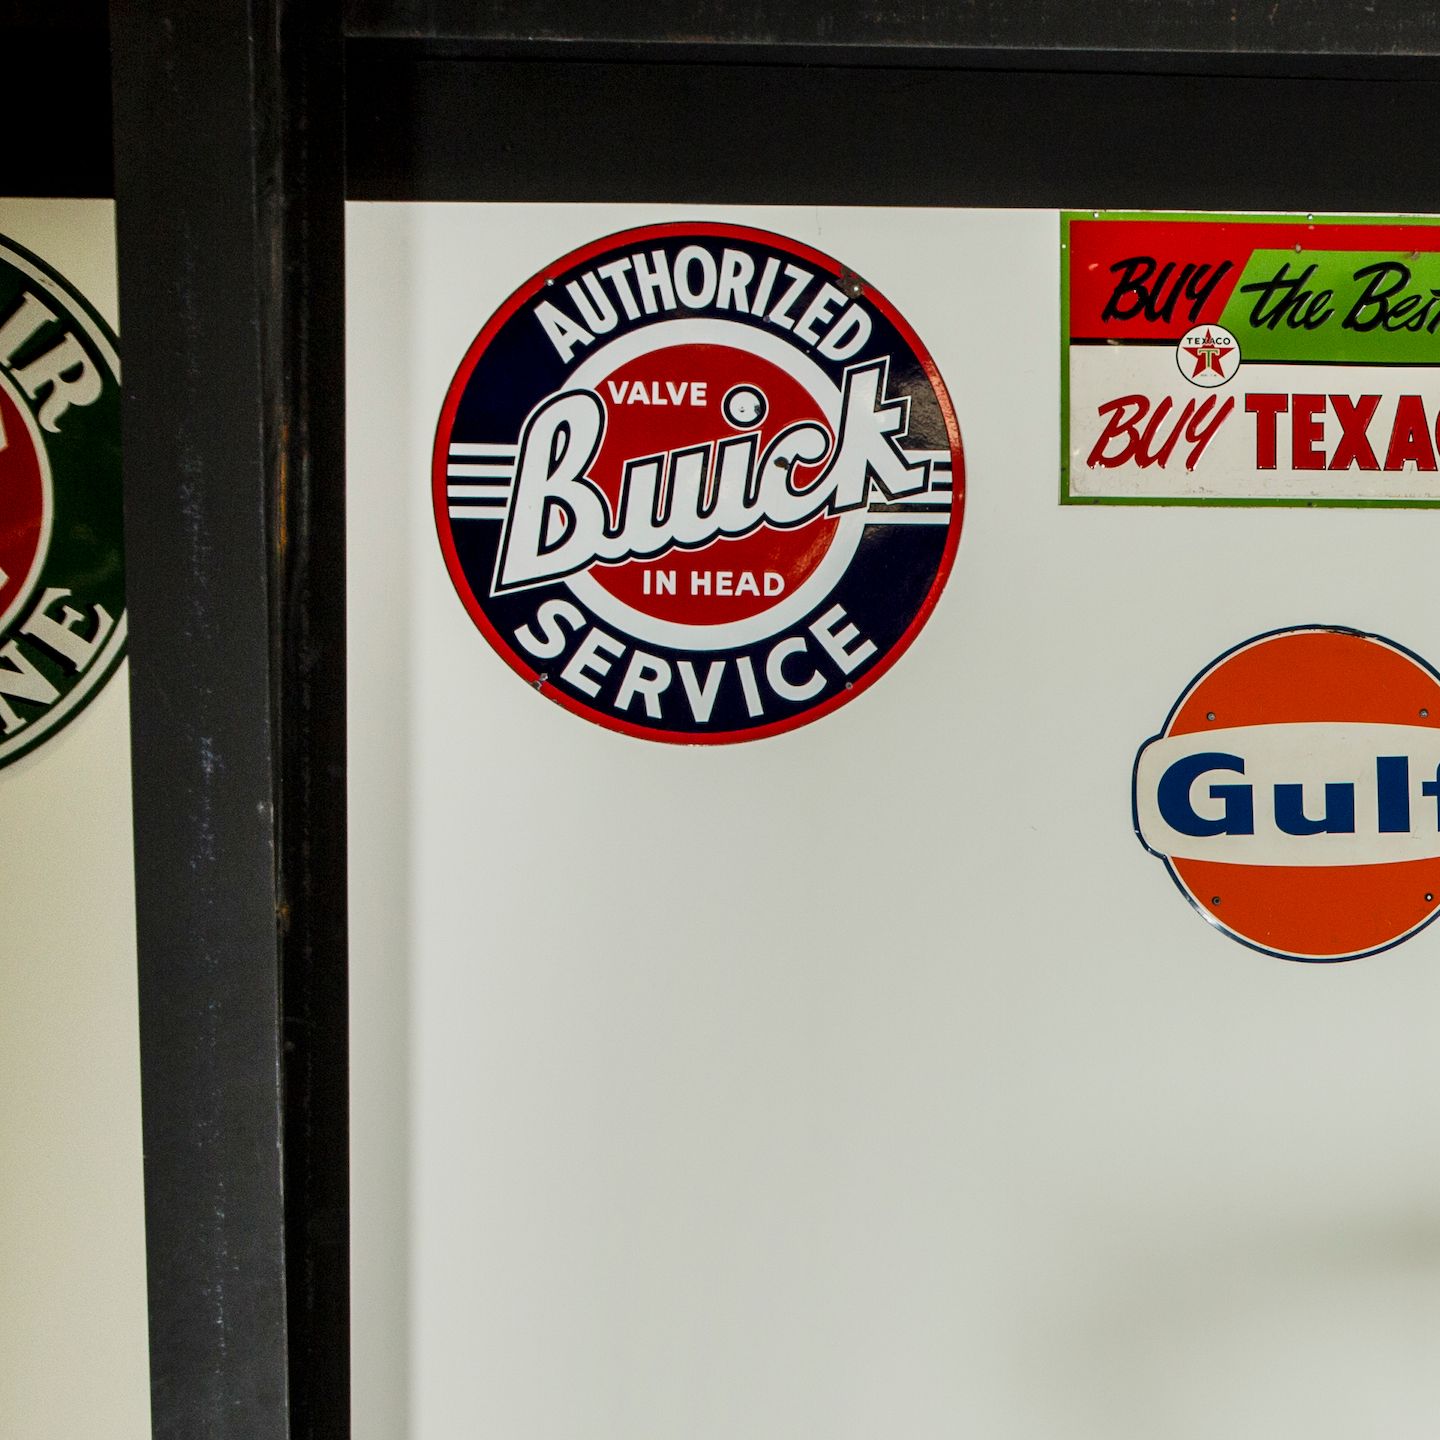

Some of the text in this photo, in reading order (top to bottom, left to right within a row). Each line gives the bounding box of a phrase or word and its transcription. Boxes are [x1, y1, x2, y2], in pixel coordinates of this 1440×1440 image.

[533, 245, 873, 364] AUTHORIZED
[1102, 256, 1234, 324] BUY
[1239, 262, 1335, 330] the
[1186, 337, 1231, 347] TEXACO
[607, 380, 708, 407] VALVE
[1086, 394, 1235, 472] BUY
[490, 354, 931, 598] Buick
[643, 569, 786, 598] IN HEAD
[514, 599, 878, 722] SERVICE
